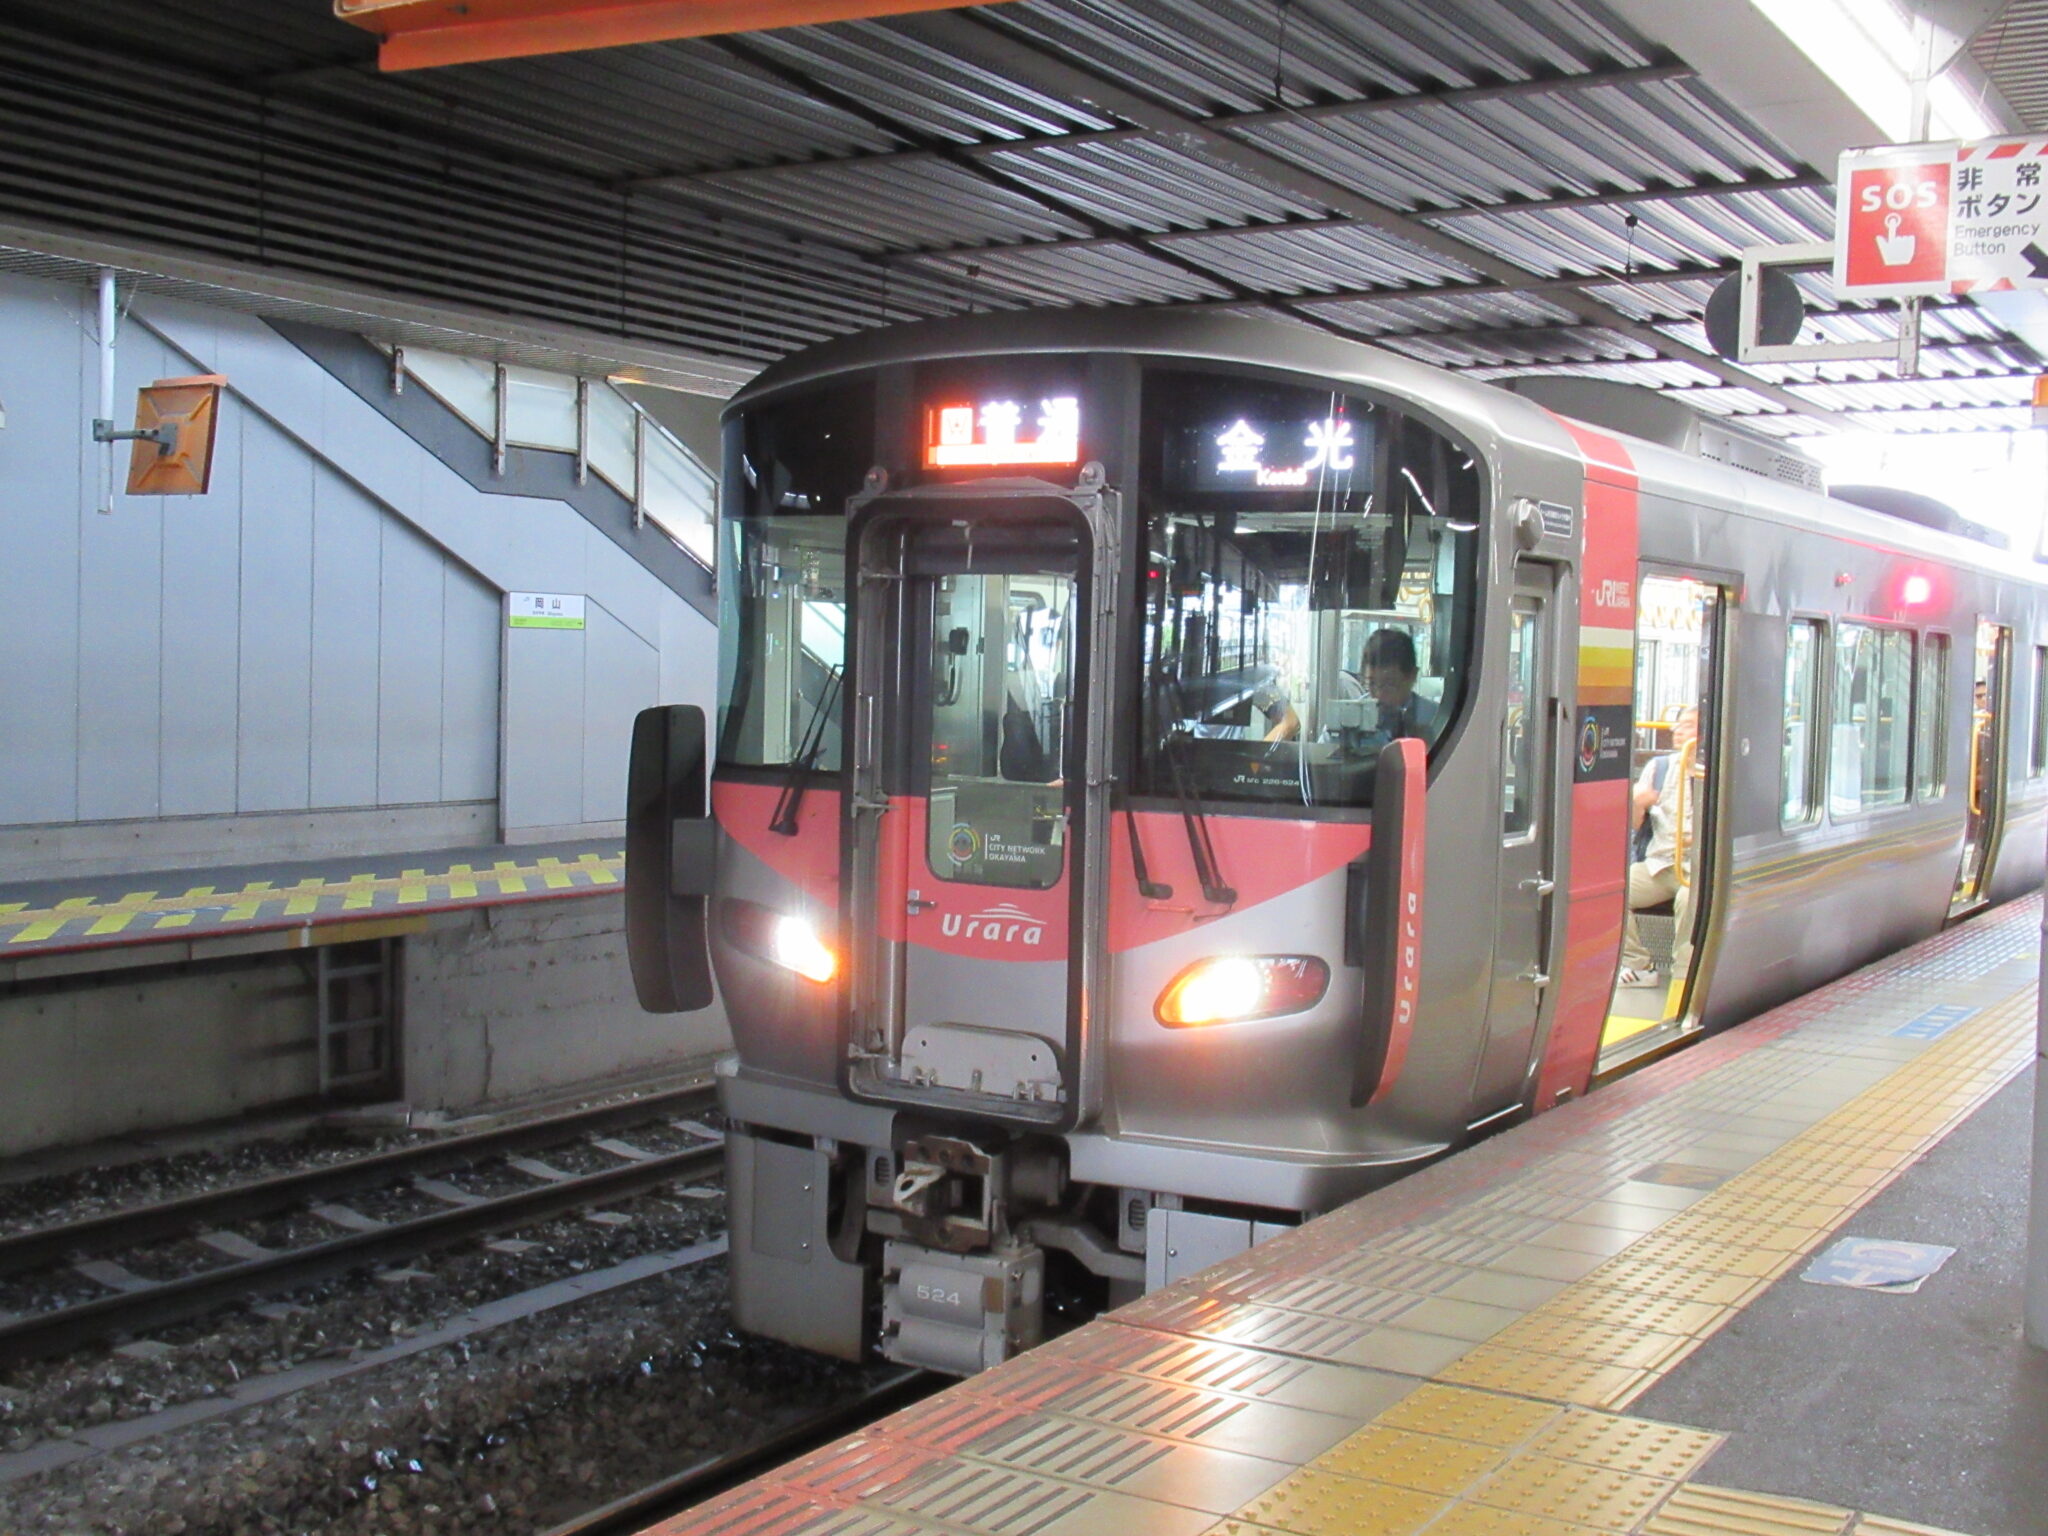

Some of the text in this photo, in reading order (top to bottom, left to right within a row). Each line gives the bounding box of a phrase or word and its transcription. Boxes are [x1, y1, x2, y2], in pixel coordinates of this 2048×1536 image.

[1957, 162, 2042, 190] 非常
[1860, 180, 1938, 213] SOS
[1956, 192, 2042, 220] ボタン
[1954, 221, 2041, 240] Emergency
[1953, 240, 2007, 257] Button
[1215, 418, 1355, 471] 金光
[988, 853, 1027, 863] OKAYAMA
[989, 843, 1046, 855] CITY NETWORK
[943, 914, 1042, 945] Urara
[1399, 891, 1417, 1025] Urara
[917, 1285, 960, 1305] 524
